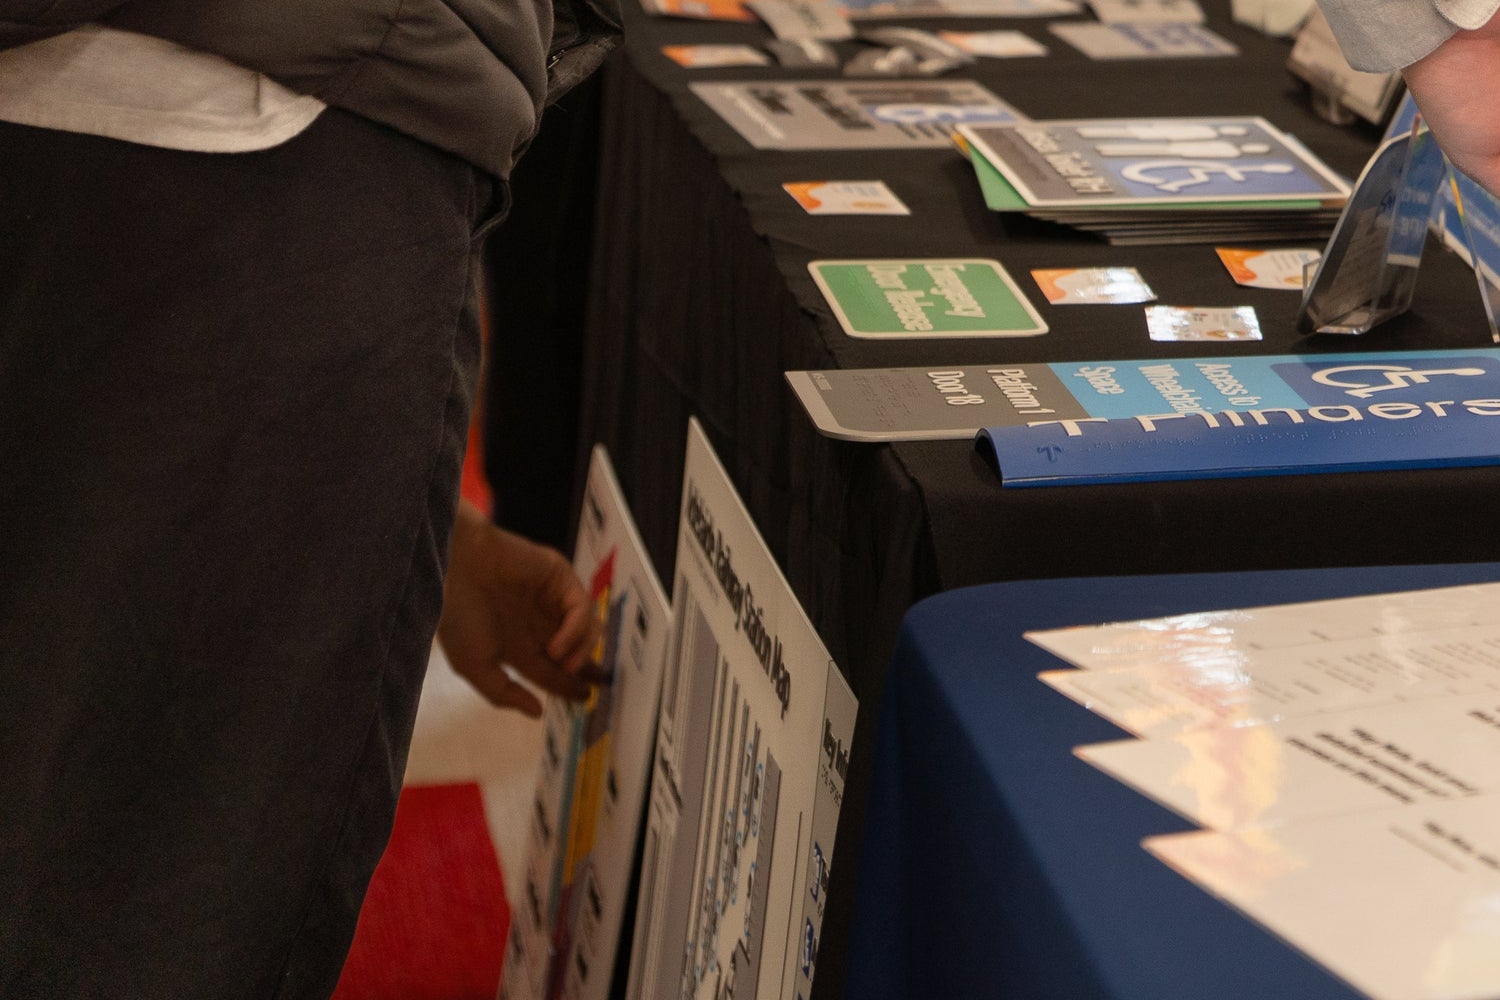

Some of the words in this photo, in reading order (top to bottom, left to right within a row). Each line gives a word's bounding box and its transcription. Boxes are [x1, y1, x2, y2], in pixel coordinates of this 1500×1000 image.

[883, 290, 935, 331] Release
[926, 370, 968, 394] Door
[945, 392, 985, 407] 18
[987, 368, 1040, 409] Platform
[1073, 365, 1125, 397] Space
[1195, 362, 1249, 396] Access
[1227, 394, 1262, 406] to
[770, 634, 791, 721] Map
